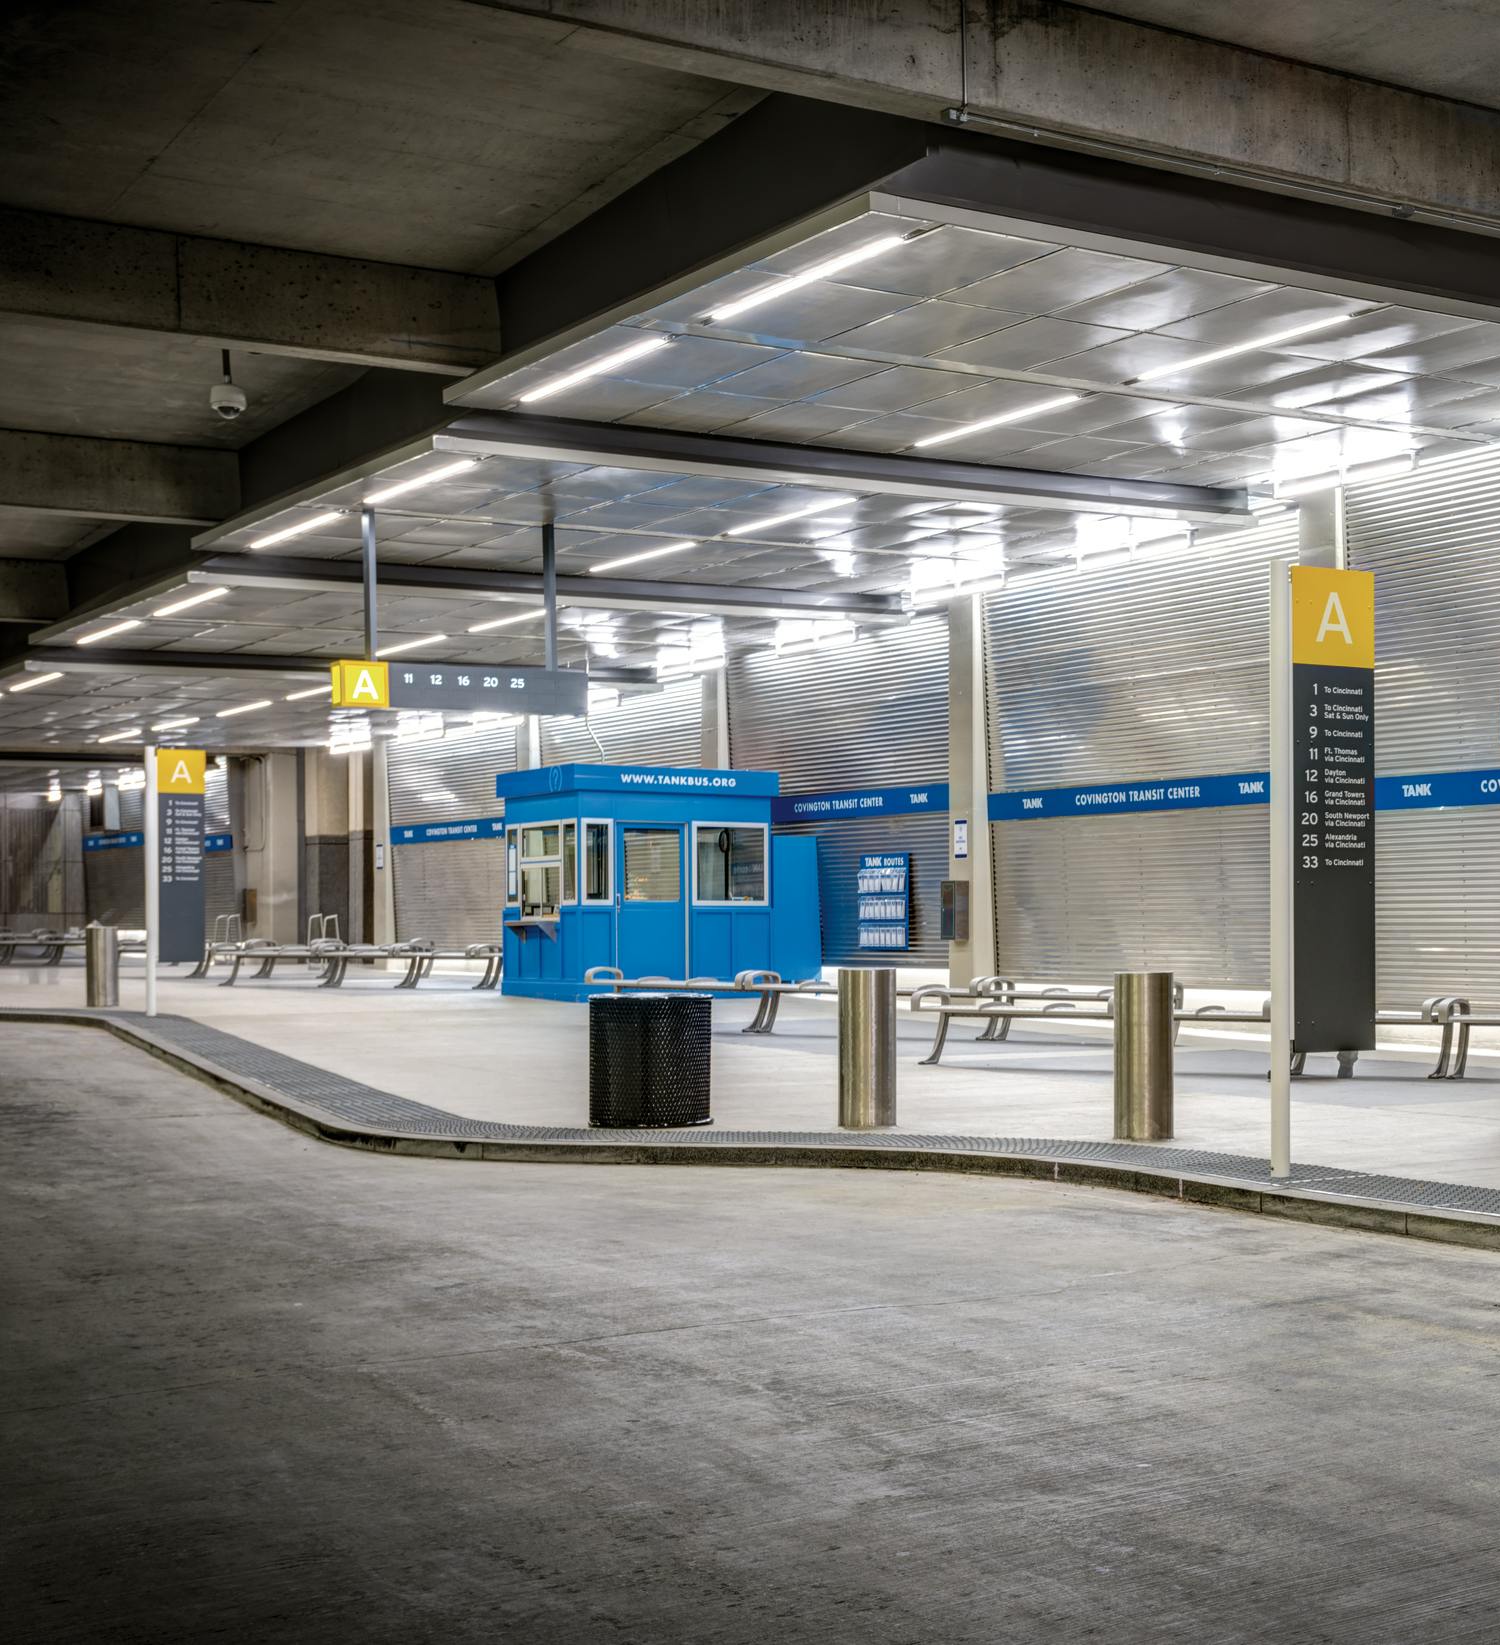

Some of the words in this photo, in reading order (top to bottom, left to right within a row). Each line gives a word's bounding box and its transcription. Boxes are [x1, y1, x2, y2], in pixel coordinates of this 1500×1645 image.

[1316, 591, 1353, 645] A
[351, 669, 379, 700] A
[403, 673, 414, 684] 11
[430, 674, 443, 685] 12
[457, 675, 470, 687] 16
[483, 677, 499, 688] 20
[510, 678, 525, 689] 25
[1312, 683, 1318, 696] 1
[1324, 686, 1332, 694] To
[1332, 686, 1363, 695] Cincinnati
[1309, 704, 1318, 717] 3
[1324, 703, 1332, 711] To
[1332, 704, 1363, 713] Cincinnati
[1336, 712, 1341, 720] &
[1342, 712, 1354, 720] Sun
[1355, 713, 1369, 722] Only
[1309, 726, 1318, 739] 9
[1324, 729, 1332, 737] To
[1332, 730, 1363, 738] Cincinnati
[1309, 747, 1318, 760] 11
[1334, 747, 1358, 755] Thomas
[1335, 755, 1365, 763] Cincinnati
[170, 759, 193, 784] A
[1304, 769, 1318, 782] 12
[1324, 768, 1346, 777] Dayton
[620, 773, 737, 788] WWW.TANKBUS.ORG
[1335, 776, 1366, 785] Cincinnati
[1238, 781, 1264, 794] TANK
[1344, 790, 1365, 798] Towers
[1401, 783, 1432, 797] TANK
[794, 801, 831, 813] COVINGTON
[832, 798, 858, 810] TRANSIT
[860, 796, 884, 808] CENTER
[909, 792, 928, 804] TANK
[1022, 797, 1043, 809] TANK
[1075, 791, 1126, 806] COVINGTON
[1128, 788, 1165, 802] TRANSIT
[1167, 785, 1200, 799] CENTER
[1304, 790, 1318, 804] 16
[1335, 798, 1366, 806] Cincinnati
[1301, 812, 1318, 825] 20
[1344, 812, 1370, 820] Newport
[164, 837, 173, 845] 12
[1302, 834, 1319, 847] 25
[1325, 833, 1357, 841] Alexandria
[1335, 841, 1366, 849] Cincinnati
[864, 856, 882, 867] TANK
[883, 857, 904, 867] ROUTES
[1302, 855, 1319, 869] 33
[1333, 858, 1364, 866] Cincinnati
